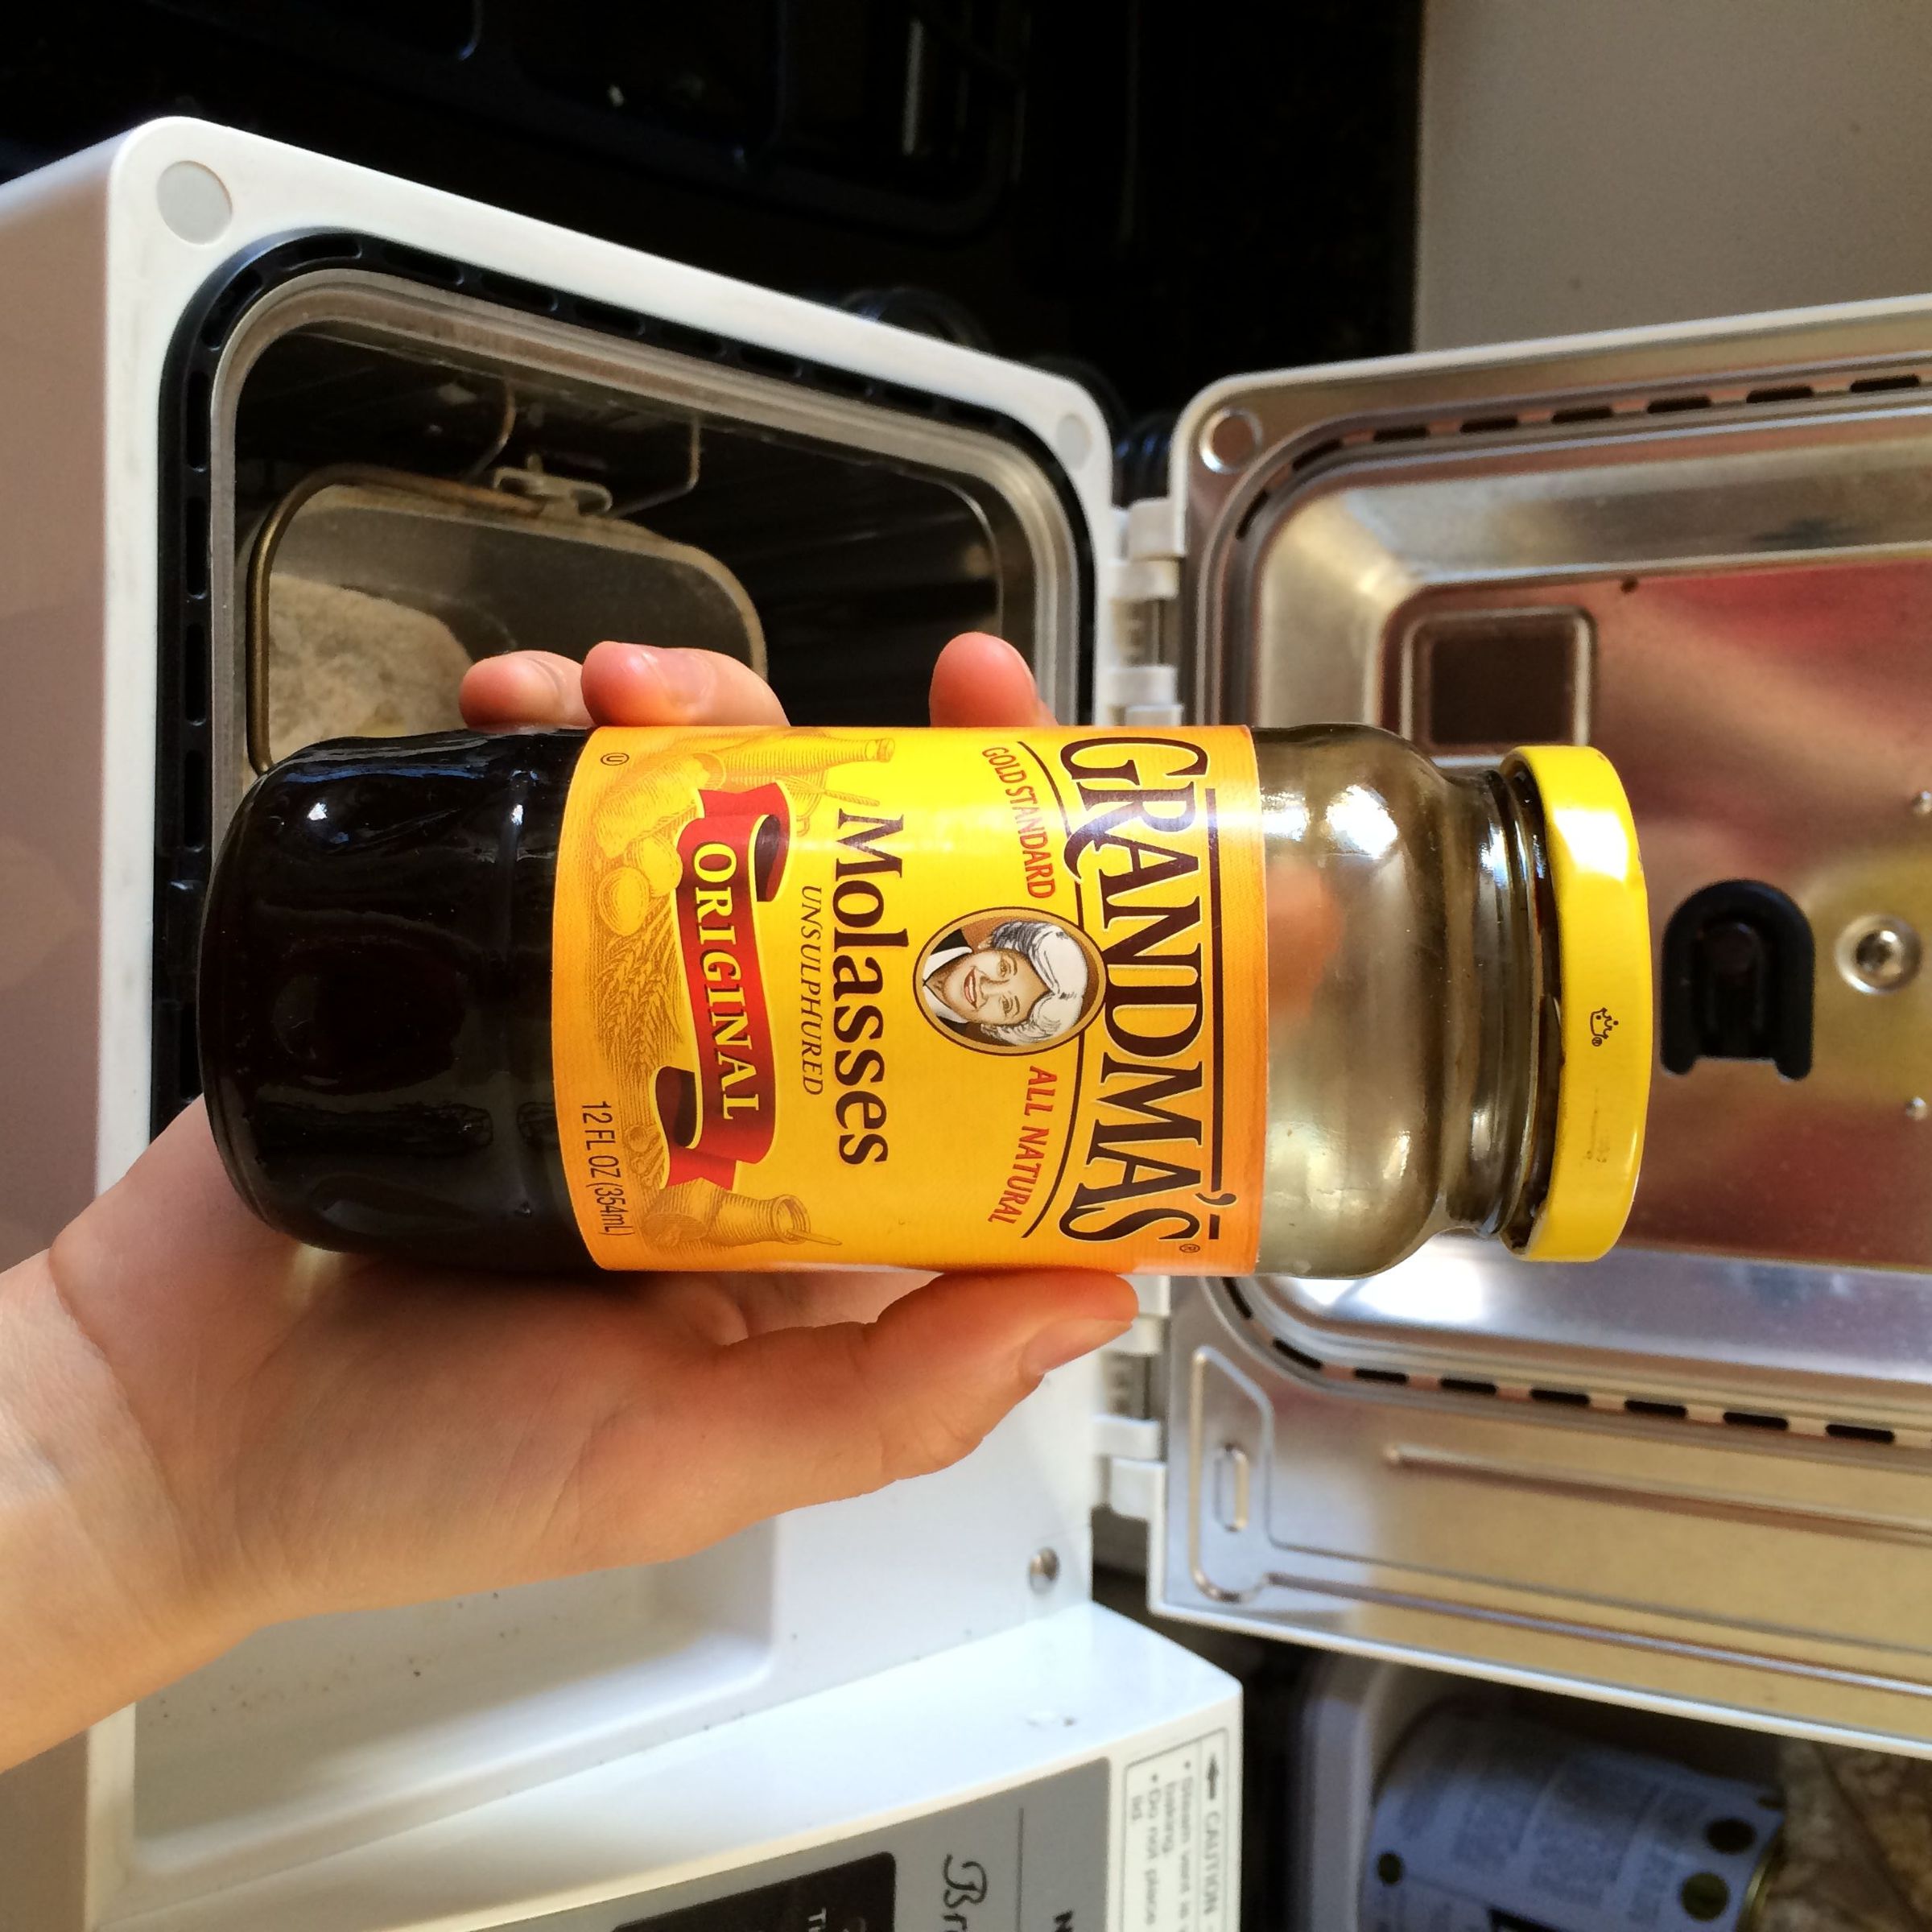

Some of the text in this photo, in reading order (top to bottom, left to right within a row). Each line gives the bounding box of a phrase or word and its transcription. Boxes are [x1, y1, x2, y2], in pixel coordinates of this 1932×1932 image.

[981, 746, 1056, 899] GOLD STANDARD
[691, 841, 760, 1121] ORIGINAL
[800, 886, 824, 1096] UNSULPHURED
[832, 807, 909, 1166] Molasses
[1059, 737, 1237, 1241] GRANDMA'S
[581, 1100, 636, 1236] 12 FL OZ (354mL)
[987, 1065, 1058, 1224] ALL NATURAL
[1203, 1810, 1220, 1915] CAUTION
